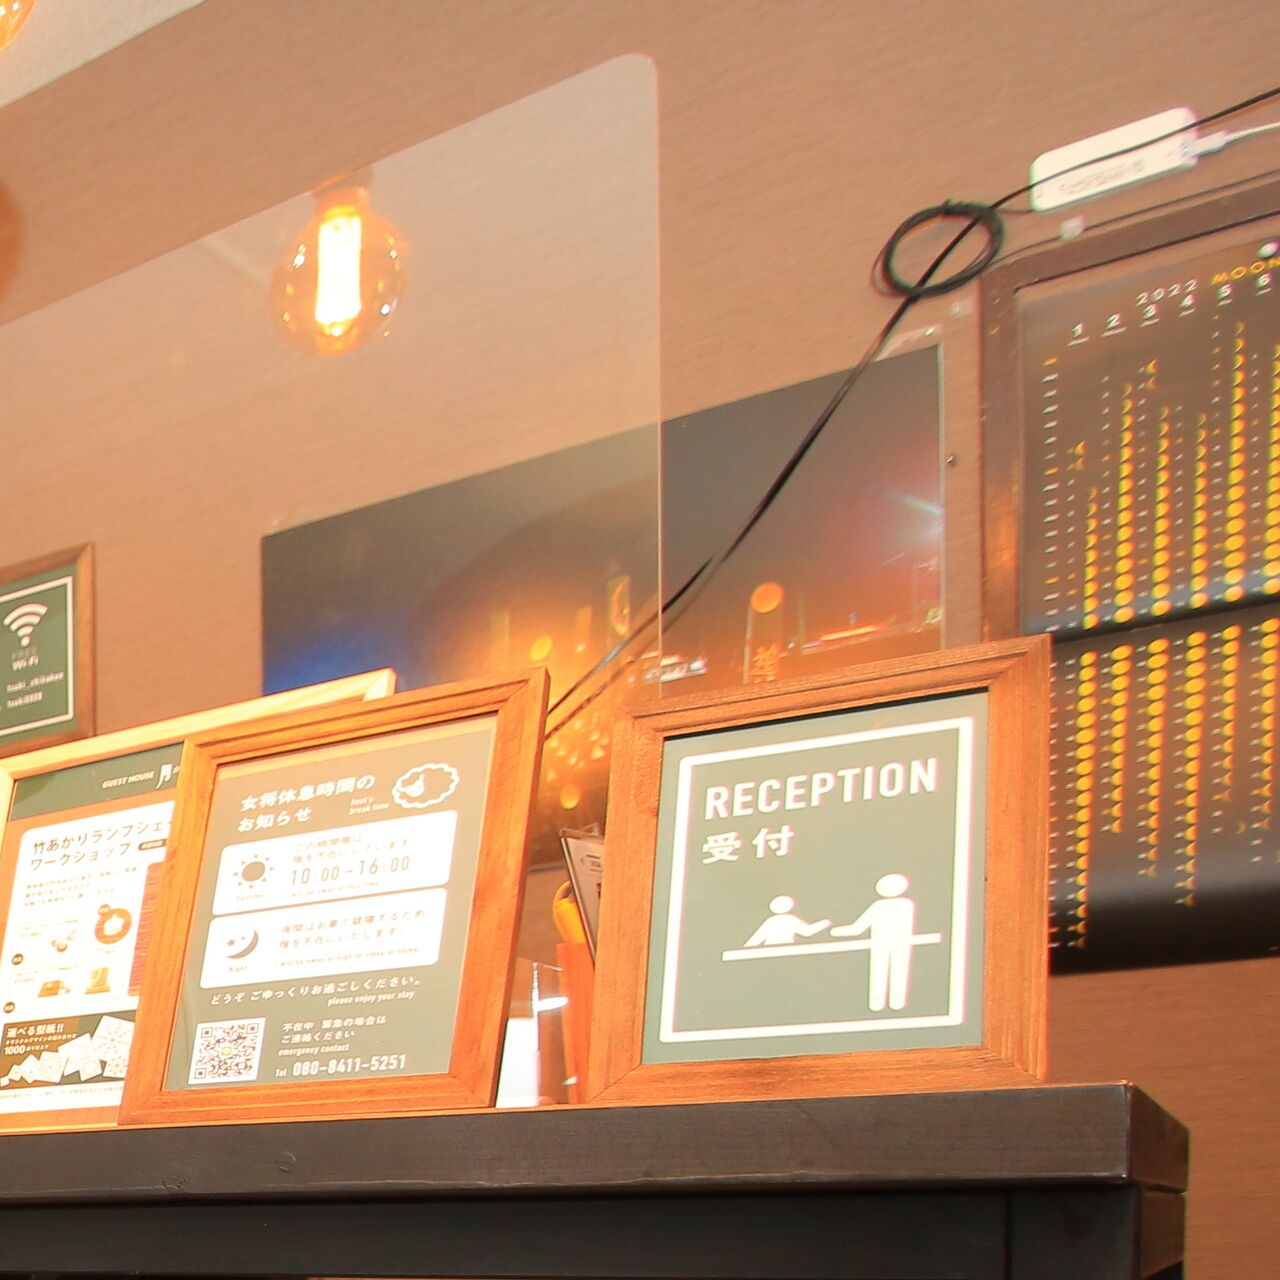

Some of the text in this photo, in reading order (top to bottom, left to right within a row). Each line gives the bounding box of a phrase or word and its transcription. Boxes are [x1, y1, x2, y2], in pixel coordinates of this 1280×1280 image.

[1136, 278, 1199, 307] 2022
[102, 776, 128, 788] GUEST
[241, 775, 376, 812] 女将休息時間の
[704, 757, 937, 820] RECEPTION
[237, 808, 312, 832] お知らせ
[33, 822, 172, 855] 竹あかりランプシェ
[702, 824, 794, 864] 受付
[31, 843, 131, 871] ワークショップ
[292, 1054, 407, 1077] 080-8411-5251
